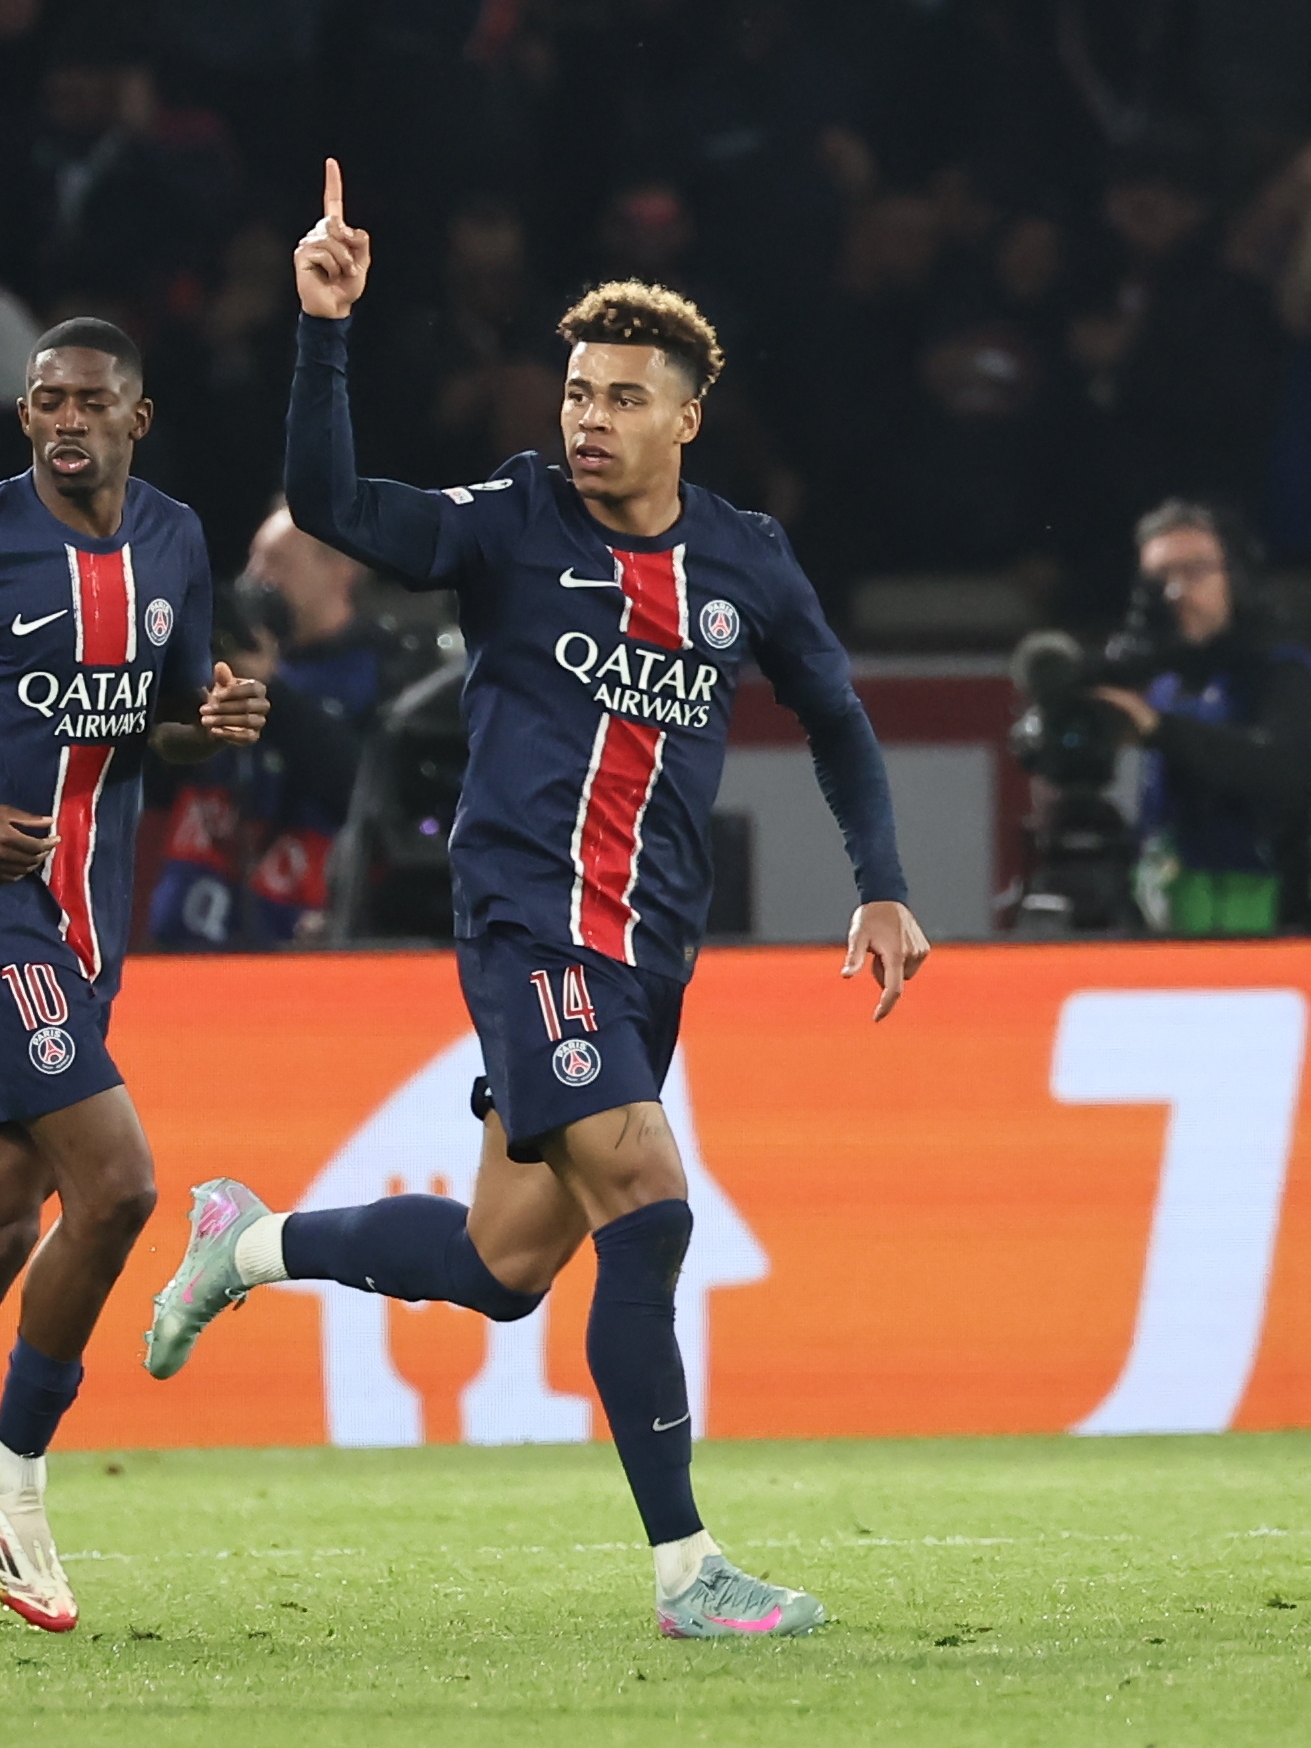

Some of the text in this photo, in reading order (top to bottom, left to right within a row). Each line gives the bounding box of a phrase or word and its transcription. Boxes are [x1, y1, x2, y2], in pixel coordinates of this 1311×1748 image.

[555, 631, 718, 702] QATAR
[17, 671, 154, 718] QATAR
[593, 683, 710, 728] AIRWAYS
[54, 710, 147, 737] AIRWAYS
[1, 962, 69, 1031] 10
[530, 965, 599, 1042] 14
[32, 1029, 62, 1046] PARIS
[556, 1041, 587, 1058] PARIS
